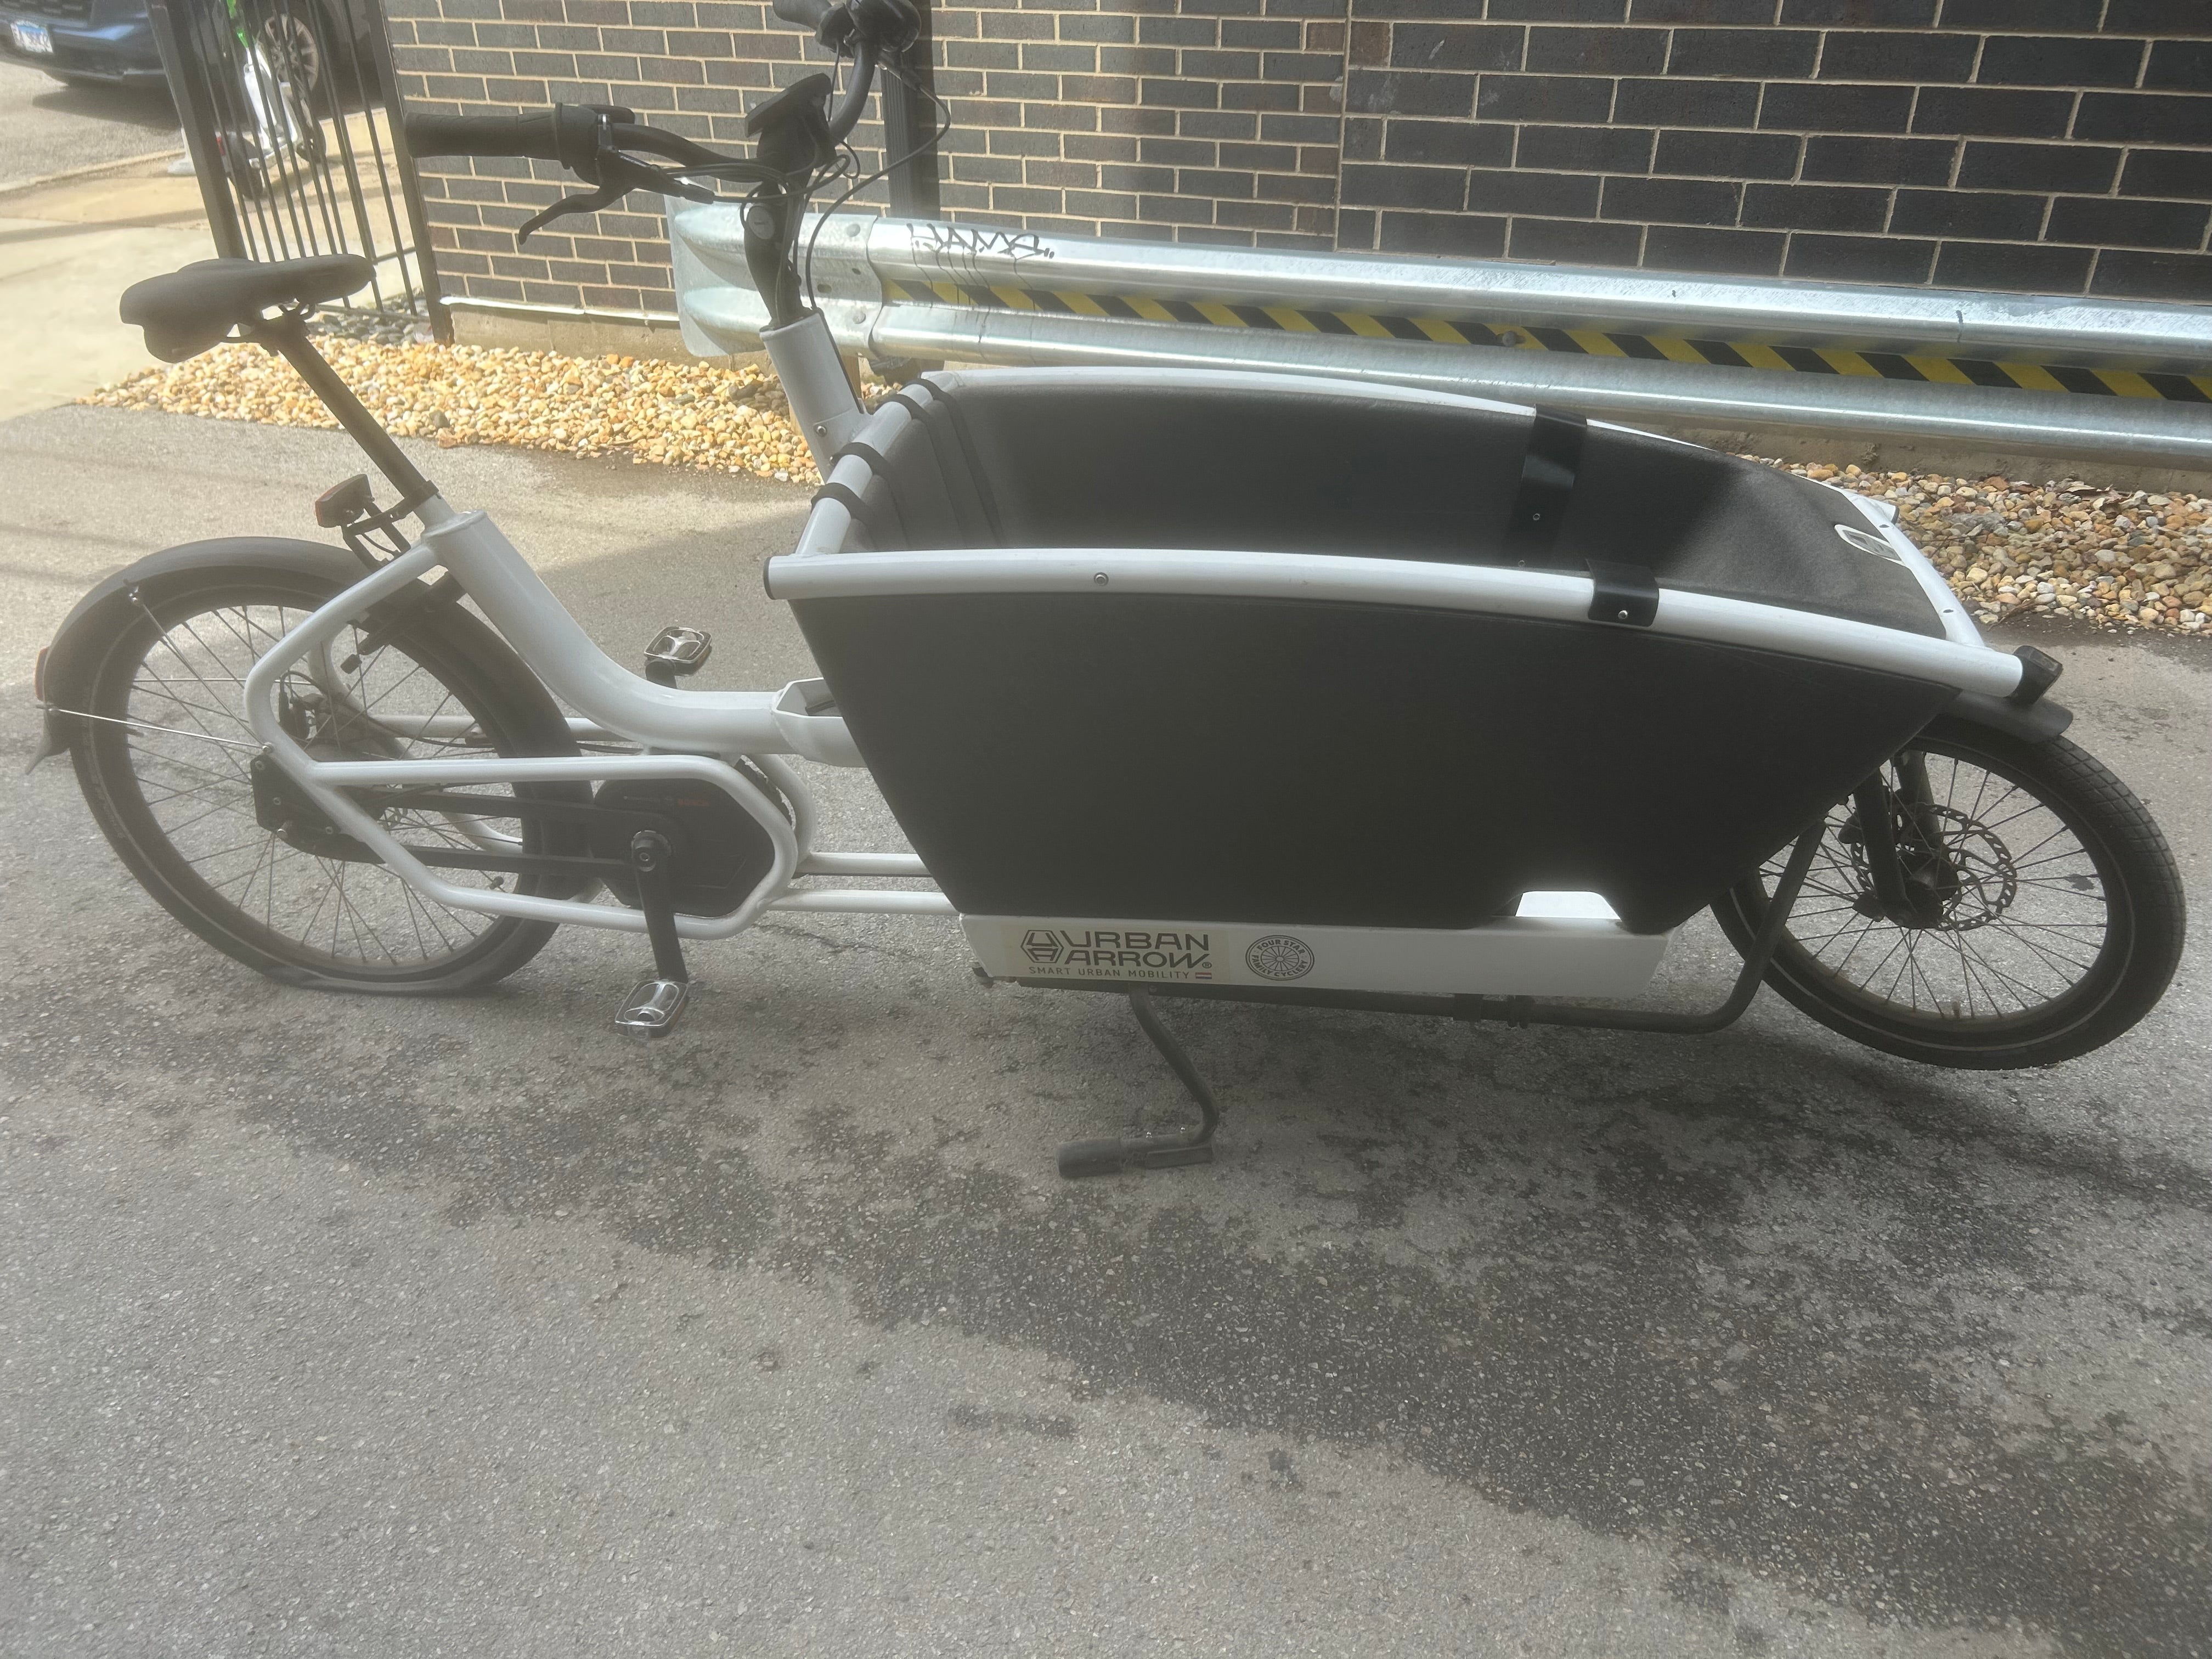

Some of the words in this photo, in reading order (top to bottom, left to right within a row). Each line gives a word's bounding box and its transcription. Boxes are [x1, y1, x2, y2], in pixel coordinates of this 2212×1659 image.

[1059, 930, 1209, 951] URBAN
[1256, 939, 1281, 951] FOUR
[1283, 940, 1306, 954] STAR
[1029, 966, 1071, 976] SMART
[1078, 968, 1121, 978] URBAN
[1128, 969, 1189, 979] MOBILITY
[1251, 955, 1273, 975] FAMILY
[1274, 960, 1308, 977] CYCLERY
